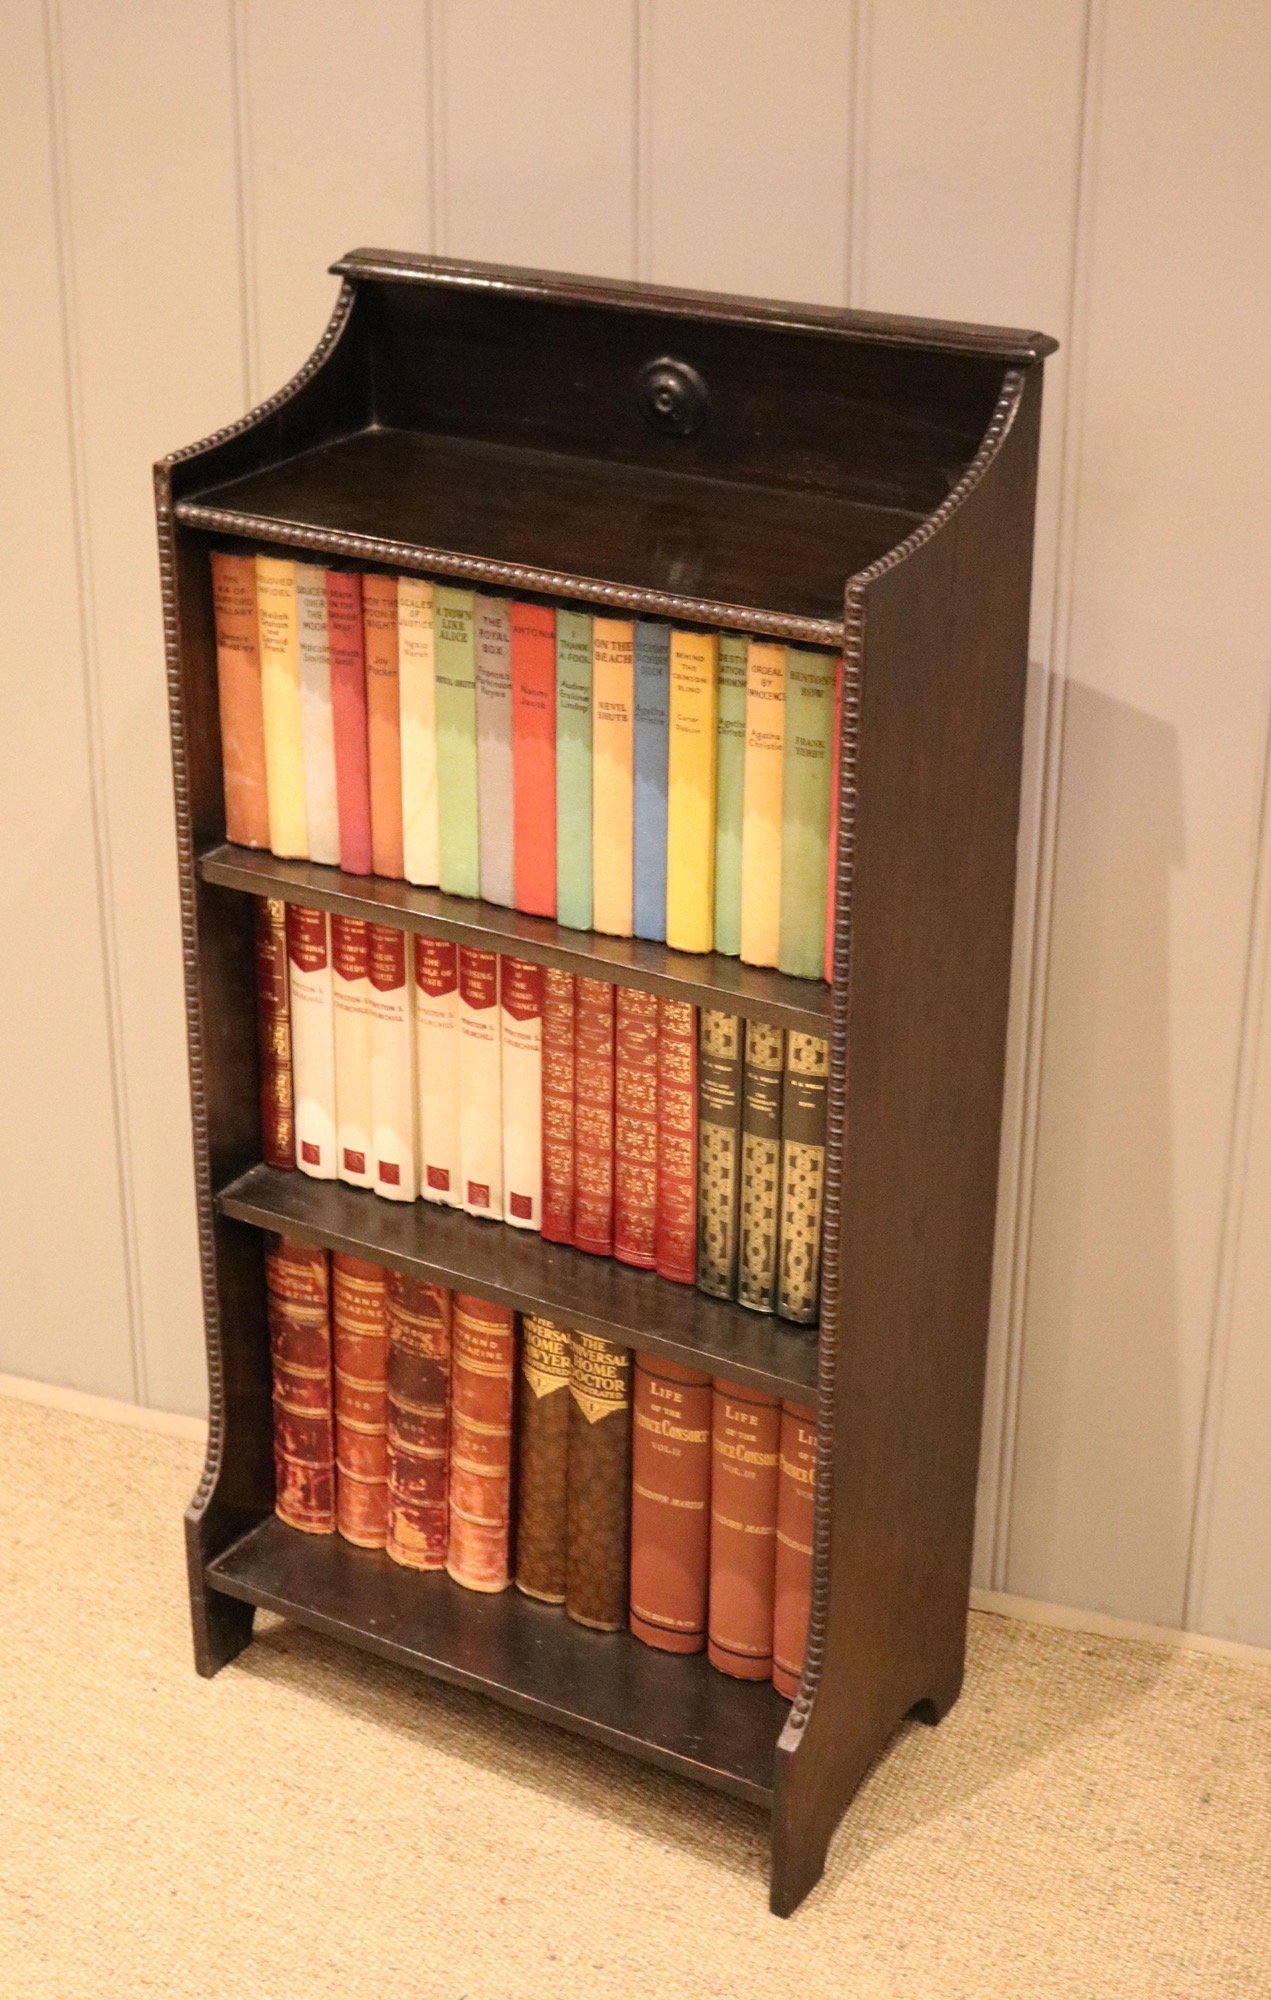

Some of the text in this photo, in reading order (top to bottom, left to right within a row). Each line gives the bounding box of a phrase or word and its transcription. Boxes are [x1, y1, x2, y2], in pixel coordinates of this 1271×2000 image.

[296, 585, 328, 596] SAUCER
[303, 598, 326, 608] OVER
[400, 598, 433, 609] SCALES
[306, 610, 322, 620] THE
[410, 610, 420, 618] OF
[436, 608, 474, 620] A TOWN
[302, 622, 327, 632] MOOR
[442, 618, 465, 631] LIKE
[482, 616, 502, 628] THE
[438, 630, 468, 643] ALICE
[479, 628, 510, 642] ROYAL
[512, 625, 556, 640] ANTONIA
[482, 644, 504, 656] BOX
[560, 640, 588, 652] THANK
[594, 638, 633, 652] ON THE
[559, 652, 592, 664] A FOOL
[594, 652, 632, 664] BEACH
[676, 652, 704, 662] BEHIND
[750, 664, 784, 677] ORDEAL
[672, 672, 708, 684] CRIMSON
[760, 678, 774, 688] BY
[562, 680, 591, 693] Audrey
[677, 684, 702, 694] BLIND
[748, 688, 786, 702] INNOCENC
[598, 701, 627, 712] NEVIL
[597, 711, 629, 722] SHUTE
[750, 729, 781, 741] Agatha
[748, 738, 784, 751] Christie
[796, 736, 826, 749] FRANK
[458, 1330, 499, 1350] TRAND
[580, 1336, 606, 1352] THE
[460, 1340, 504, 1361] GAZINE
[572, 1342, 630, 1368] UNIVERSAL
[574, 1354, 618, 1379] HOME
[650, 1382, 682, 1403] LIFE
[650, 1404, 682, 1419] OF THE
[725, 1404, 759, 1426] LIFE
[662, 1420, 709, 1443] CONSORT
[726, 1428, 758, 1442] OF THE
[736, 1444, 779, 1466] CONSOR
[798, 1452, 810, 1461] OF
